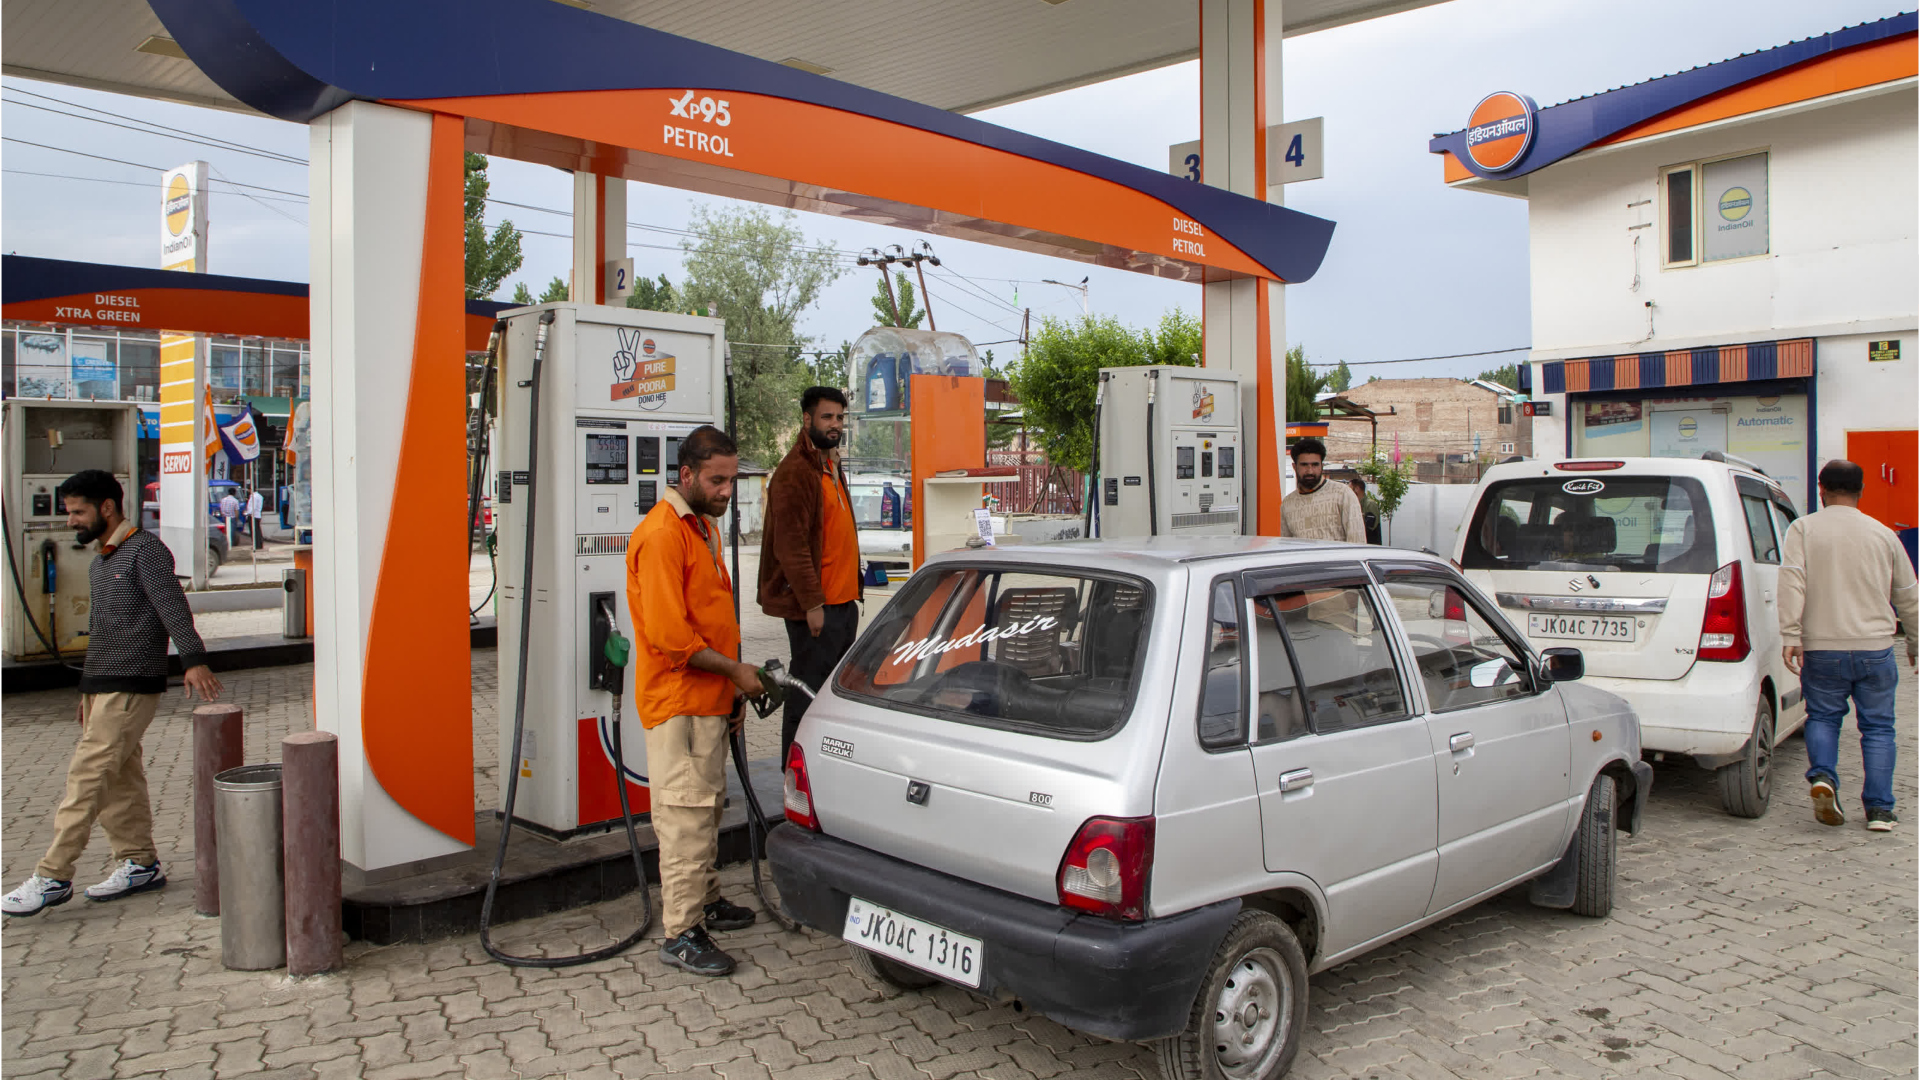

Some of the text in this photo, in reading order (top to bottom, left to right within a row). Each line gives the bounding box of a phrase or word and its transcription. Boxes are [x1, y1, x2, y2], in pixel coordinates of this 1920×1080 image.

[663, 124, 734, 157] PETROL
[1468, 118, 1526, 146] इंडियनऑयल
[1285, 133, 1305, 167] 4
[1184, 154, 1200, 183] 3
[1173, 217, 1204, 237] DIESEL
[1718, 220, 1753, 231] IndianOil
[163, 236, 192, 255] IndianOil
[1173, 237, 1206, 257] PETROL
[617, 268, 625, 290] 2
[95, 294, 140, 308] DIESEL
[55, 306, 140, 323] XTRA GREEN
[644, 361, 667, 375] PURE
[638, 378, 667, 394] POORA
[638, 391, 667, 405] DONO HEE
[1737, 415, 1794, 428] Automatic
[165, 454, 190, 472] SERVO
[1541, 618, 1628, 637] JK04C 7735
[893, 614, 1058, 666] Mudasir
[822, 744, 853, 758] SUZUKI
[823, 737, 854, 751] MARUTI
[1031, 793, 1051, 805] 800
[849, 915, 860, 925] IND
[860, 912, 973, 974] JK04C 1316
